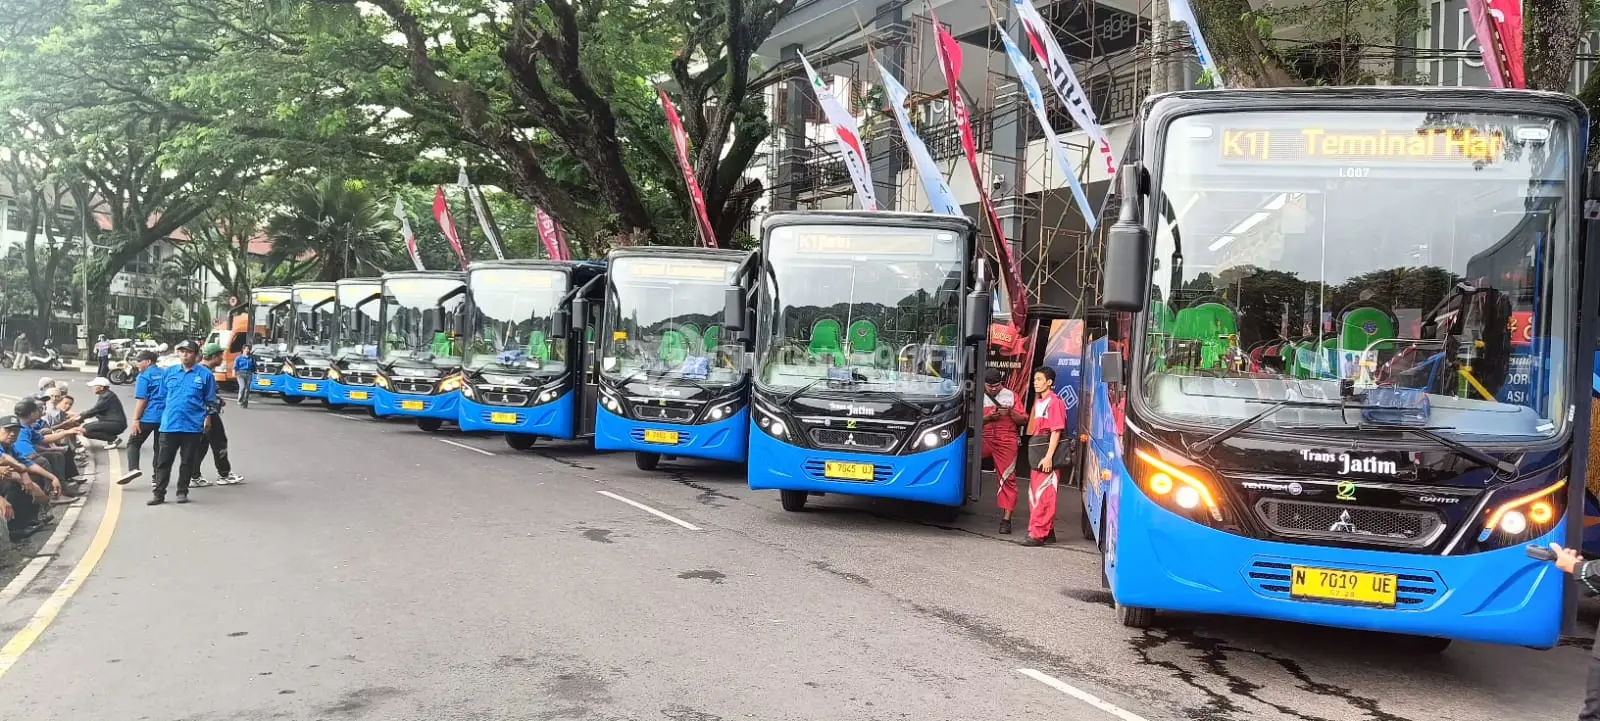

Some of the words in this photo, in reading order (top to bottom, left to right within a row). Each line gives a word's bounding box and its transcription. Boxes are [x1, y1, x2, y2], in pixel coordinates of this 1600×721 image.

[1303, 129, 1434, 156] Terminal
[847, 404, 875, 416] Jatim
[838, 463, 856, 473] 7045
[1300, 449, 1336, 462] Trans
[1337, 453, 1397, 475] Jatim
[1242, 482, 1287, 490] TENTREM
[1419, 495, 1460, 504] CANTER
[1295, 570, 1306, 586] N
[1319, 572, 1358, 589] 7019
[1372, 576, 1392, 593] UE
